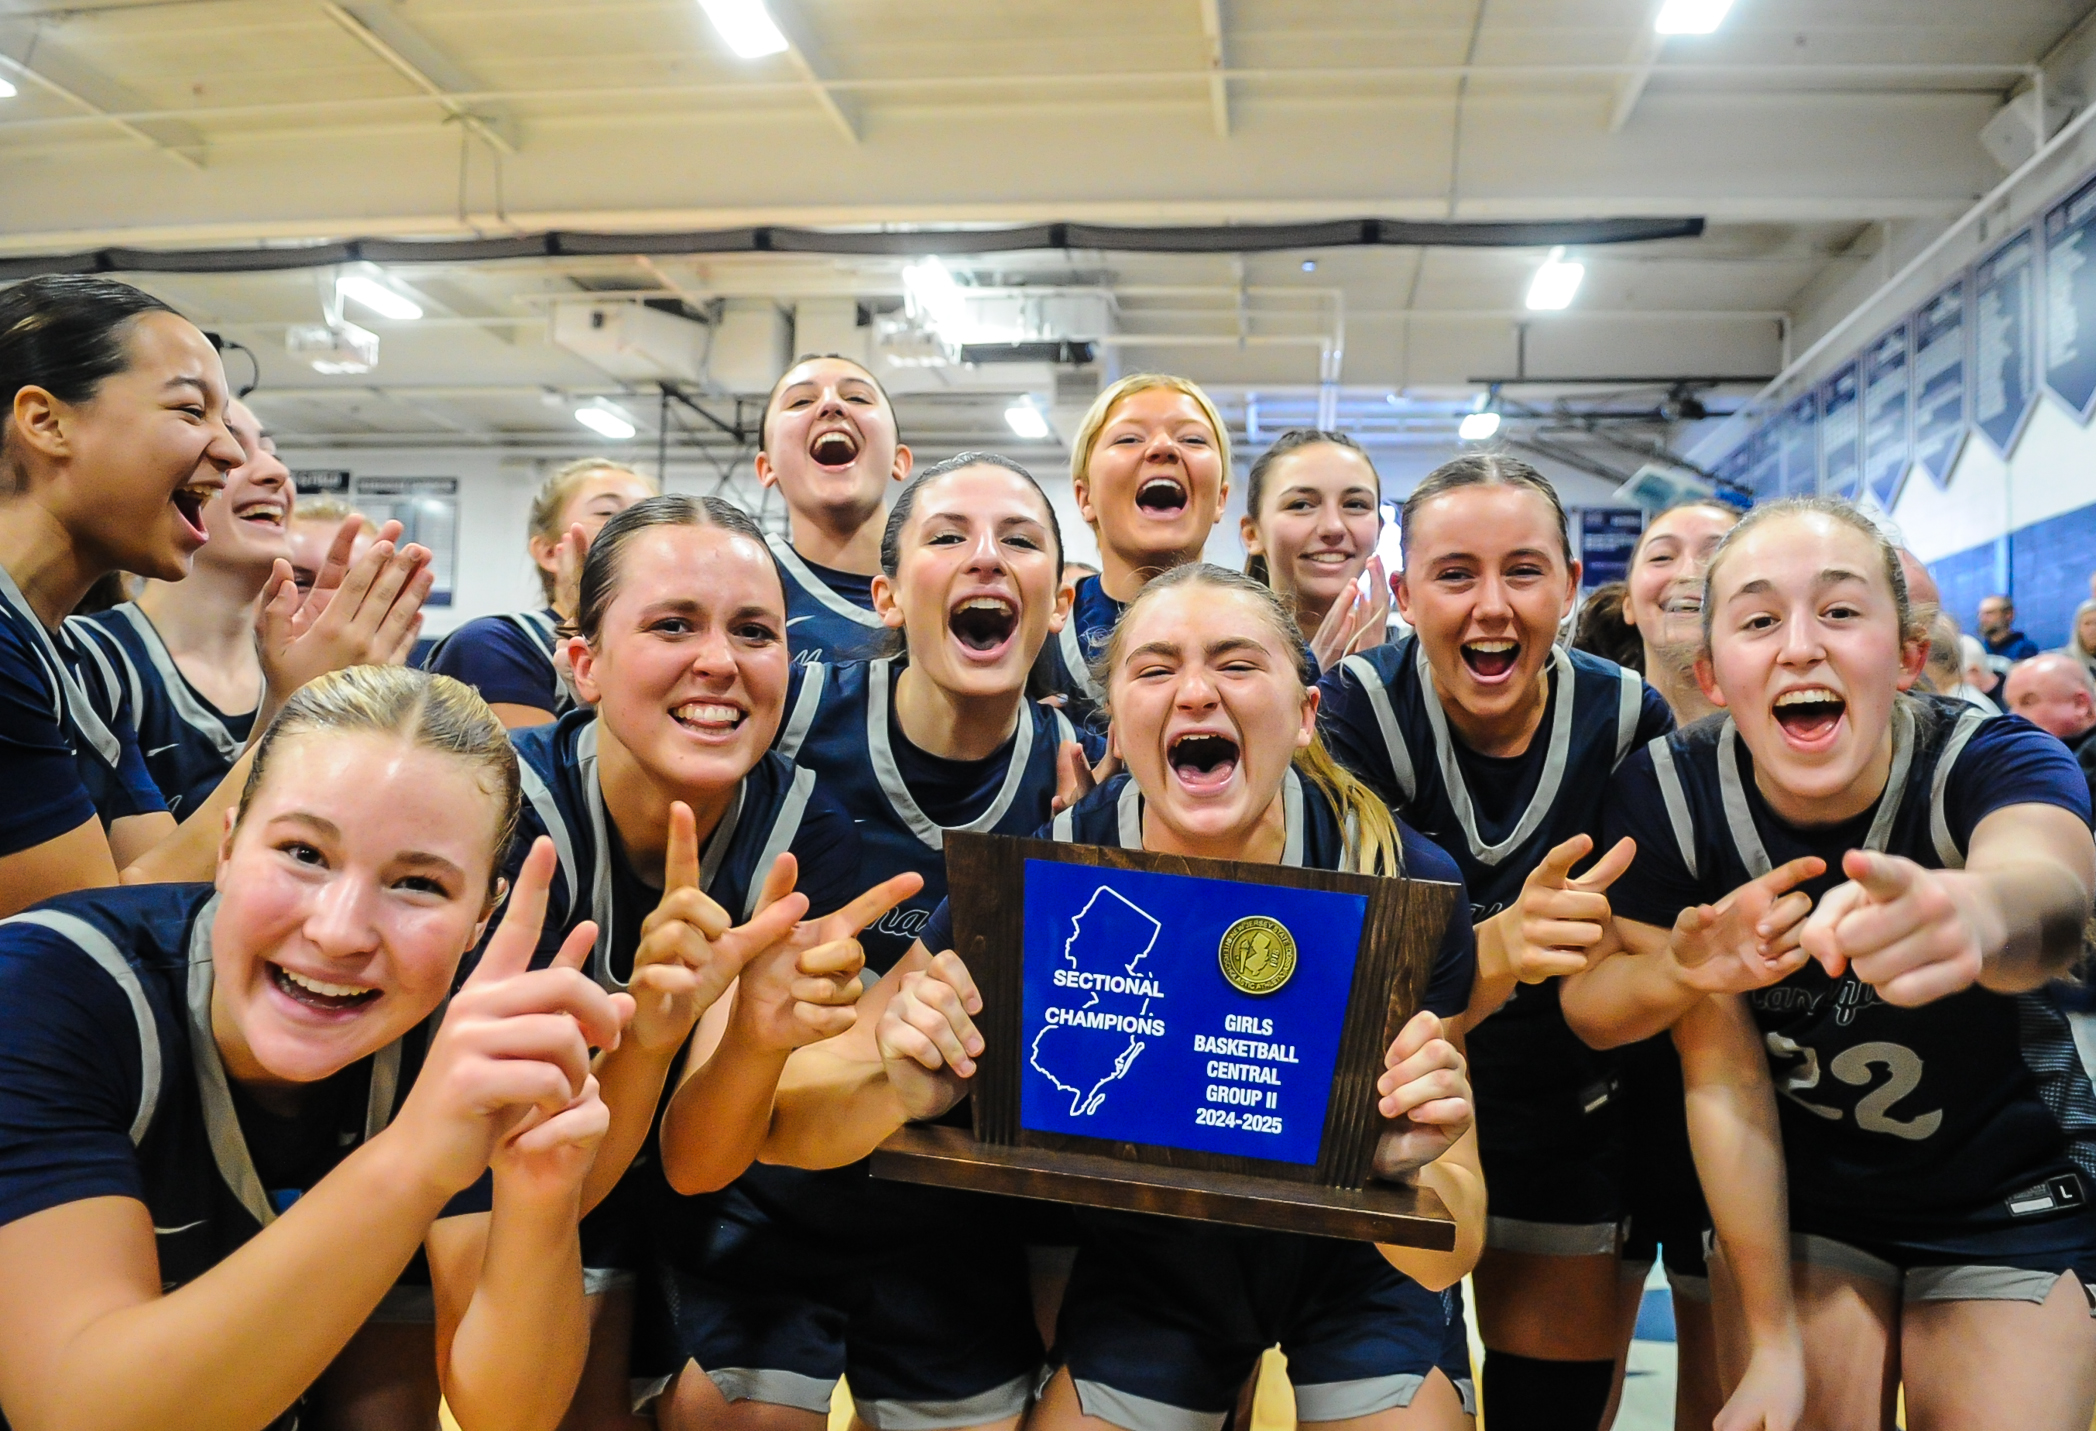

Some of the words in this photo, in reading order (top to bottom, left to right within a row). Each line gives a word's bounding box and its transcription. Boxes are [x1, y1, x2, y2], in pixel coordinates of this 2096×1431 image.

[1269, 949, 1280, 968] 1918
[1053, 969, 1165, 999] SECTIONAL
[1045, 1007, 1165, 1037] CHAMPIONS
[1224, 1014, 1274, 1036] GIRLS
[1194, 1034, 1299, 1064] BASKETBALL
[1206, 1060, 1282, 1086] CENTRAL
[1206, 1084, 1263, 1107] GROUP
[1265, 1091, 1278, 1110] II
[1195, 1107, 1283, 1135] 2024-2025
[2059, 1185, 2073, 1199] L
